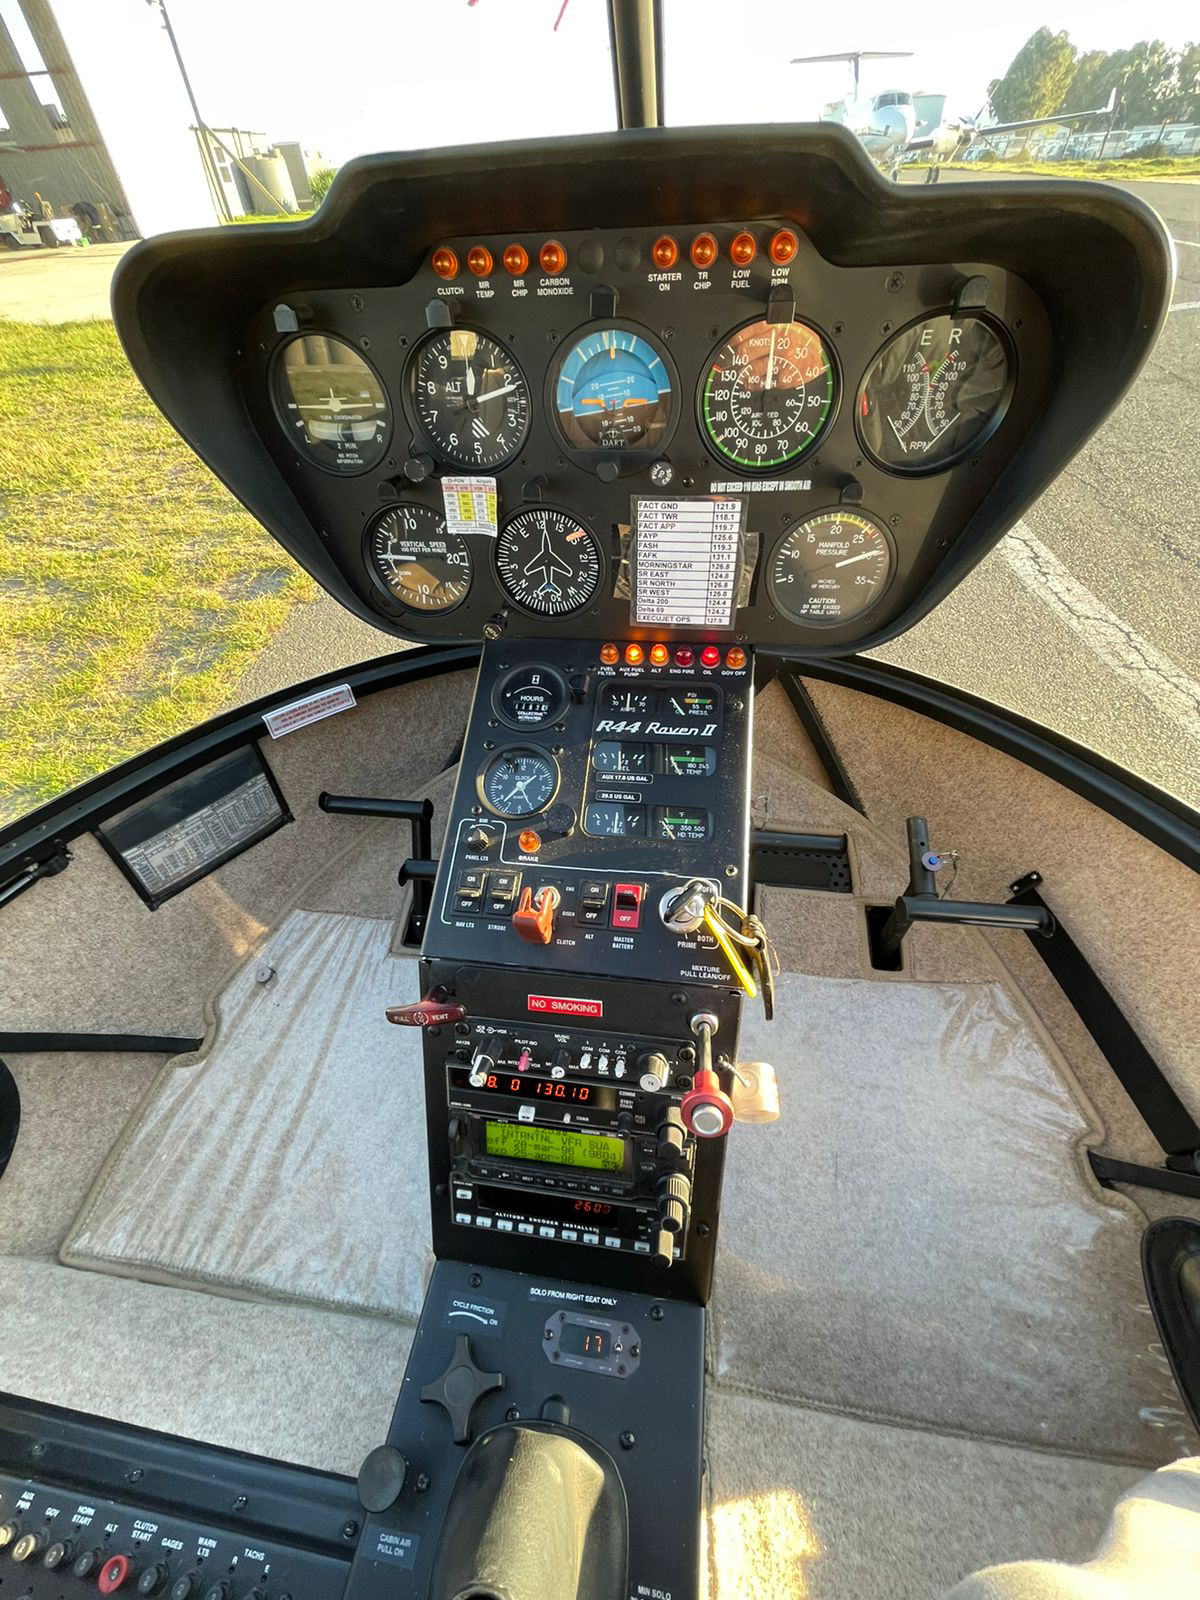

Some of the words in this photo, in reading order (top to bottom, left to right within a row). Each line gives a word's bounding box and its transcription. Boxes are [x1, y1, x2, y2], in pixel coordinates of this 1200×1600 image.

[698, 272, 709, 281] TR
[732, 270, 751, 279] LOW
[771, 268, 790, 277] LOW
[648, 273, 682, 282] STARTER
[478, 281, 490, 289] MR
[513, 280, 525, 288] MR
[539, 278, 570, 287] CARBON
[693, 282, 712, 290] CHIP
[731, 280, 750, 289] FUEL
[437, 287, 464, 296] CLUTCH
[537, 287, 574, 296] MONOXIDE
[659, 283, 671, 292] ON
[475, 290, 495, 299] TEMP
[511, 289, 529, 298] CHIP
[921, 330, 934, 345] E
[949, 328, 962, 344] R
[778, 338, 790, 349] 20
[794, 348, 808, 358] 30
[732, 355, 749, 365] 140
[721, 370, 737, 381] 130
[806, 367, 820, 377] 40
[445, 381, 462, 393] ALT
[715, 390, 730, 400] 120
[807, 396, 821, 406] 50
[715, 411, 728, 421] 110
[795, 422, 808, 432] 60
[724, 427, 740, 437] 100
[602, 439, 625, 447] DART
[735, 438, 749, 448] 90
[777, 440, 789, 450] 70
[755, 444, 768, 454] 80
[638, 502, 659, 510] FACT
[660, 502, 679, 510] GND
[716, 503, 736, 511] 121.9
[638, 512, 659, 520] FACT
[660, 512, 679, 520] TWR
[715, 513, 735, 521] 118.1
[404, 518, 417, 530] 10
[638, 522, 659, 530] FACT
[830, 525, 843, 535] 20
[638, 532, 659, 540] FAYP
[713, 534, 733, 542] 125.6
[806, 533, 816, 543] 15
[852, 534, 865, 544] 25
[400, 541, 426, 549] VERTICAL
[429, 541, 447, 549] SPEED
[638, 542, 659, 550] FASH
[818, 541, 850, 549] MANIFOLD
[446, 553, 460, 564] 20
[638, 552, 658, 560] FAFK
[712, 553, 731, 561] 131.1
[790, 550, 800, 559] 10
[638, 561, 693, 570] MORNINGSTAR
[711, 562, 731, 570] 126.8
[650, 571, 669, 579] EAST
[710, 572, 730, 580] 124.8
[650, 580, 676, 588] NORTH
[710, 581, 729, 589] 126.8
[854, 576, 866, 585] 35
[638, 588, 648, 596] SR
[650, 589, 671, 597] WEST
[708, 599, 727, 607] 124.4
[808, 597, 837, 605] CAUTION
[707, 608, 726, 616] 124.2
[675, 615, 691, 623] OPS
[520, 694, 545, 703] HOURS
[596, 720, 642, 733] R44
[645, 722, 699, 736] Raven
[700, 724, 718, 737] II
[518, 855, 539, 863] BRAKE
[585, 912, 597, 920] OFF
[488, 924, 507, 932] STROBE
[556, 938, 576, 946] CLUTCH
[613, 936, 634, 944] MASTER
[697, 935, 714, 943] BOTH
[612, 943, 634, 951] BATTERY
[677, 941, 697, 950] PRIME
[680, 970, 698, 978] PULL
[691, 965, 721, 974] MIXTURE
[531, 1000, 547, 1009] NO
[551, 1001, 598, 1014] SMOKING
[431, 1013, 449, 1021] VENT
[561, 1138, 583, 1148] VFR
[589, 1140, 610, 1151] SUA
[495, 1210, 525, 1221] ALTITUDE
[528, 1216, 560, 1227] ENCODER
[530, 1287, 547, 1297] SOLO
[547, 1289, 565, 1299] FROM
[565, 1291, 585, 1302] RIGHT
[585, 1294, 601, 1304] SEAT
[601, 1296, 618, 1306] ONLY
[470, 1304, 495, 1315] FRICTION
[489, 1318, 498, 1326] ON
[585, 1335, 602, 1353] 17
[21, 1490, 36, 1501] AUX
[15, 1499, 31, 1510] PWR
[45, 1507, 60, 1519] GOV
[77, 1505, 96, 1517] HORN
[72, 1514, 93, 1527] START
[104, 1523, 119, 1534] ALT
[133, 1520, 158, 1534] CLUTCH
[131, 1529, 153, 1542] START
[161, 1537, 183, 1551] GAGES
[198, 1536, 217, 1549] WARN
[379, 1533, 400, 1546] CABIN
[399, 1537, 412, 1548] AIR
[197, 1546, 210, 1558] LTS
[244, 1548, 266, 1561] TACHS
[377, 1543, 394, 1556] PULL
[393, 1547, 405, 1558] ON
[637, 1585, 651, 1597] MIN
[651, 1588, 672, 1600] SOLO
